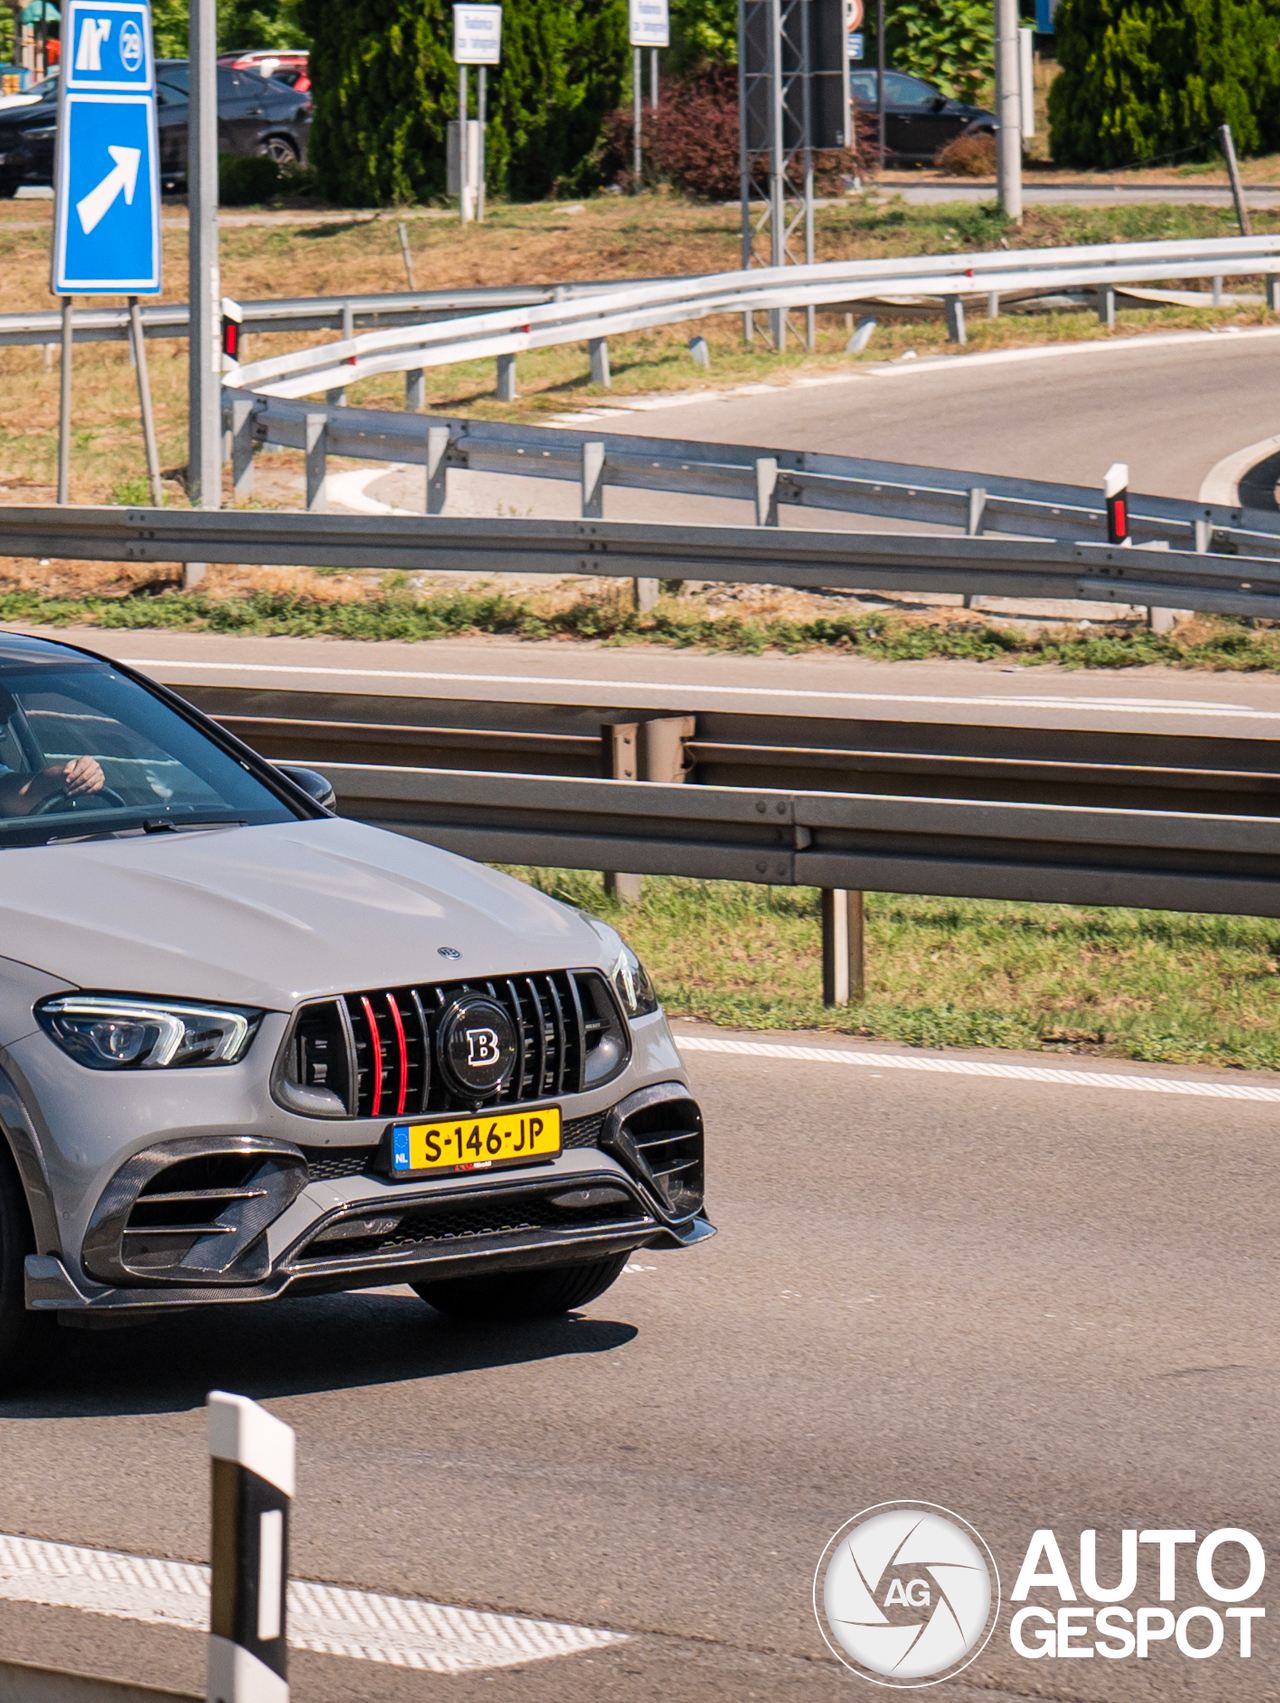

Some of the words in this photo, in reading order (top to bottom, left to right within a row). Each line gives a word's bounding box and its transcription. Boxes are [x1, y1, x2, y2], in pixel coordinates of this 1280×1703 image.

[466, 1028, 500, 1067] B
[395, 1153, 408, 1164] NL
[425, 1117, 544, 1162] S-146-JP
